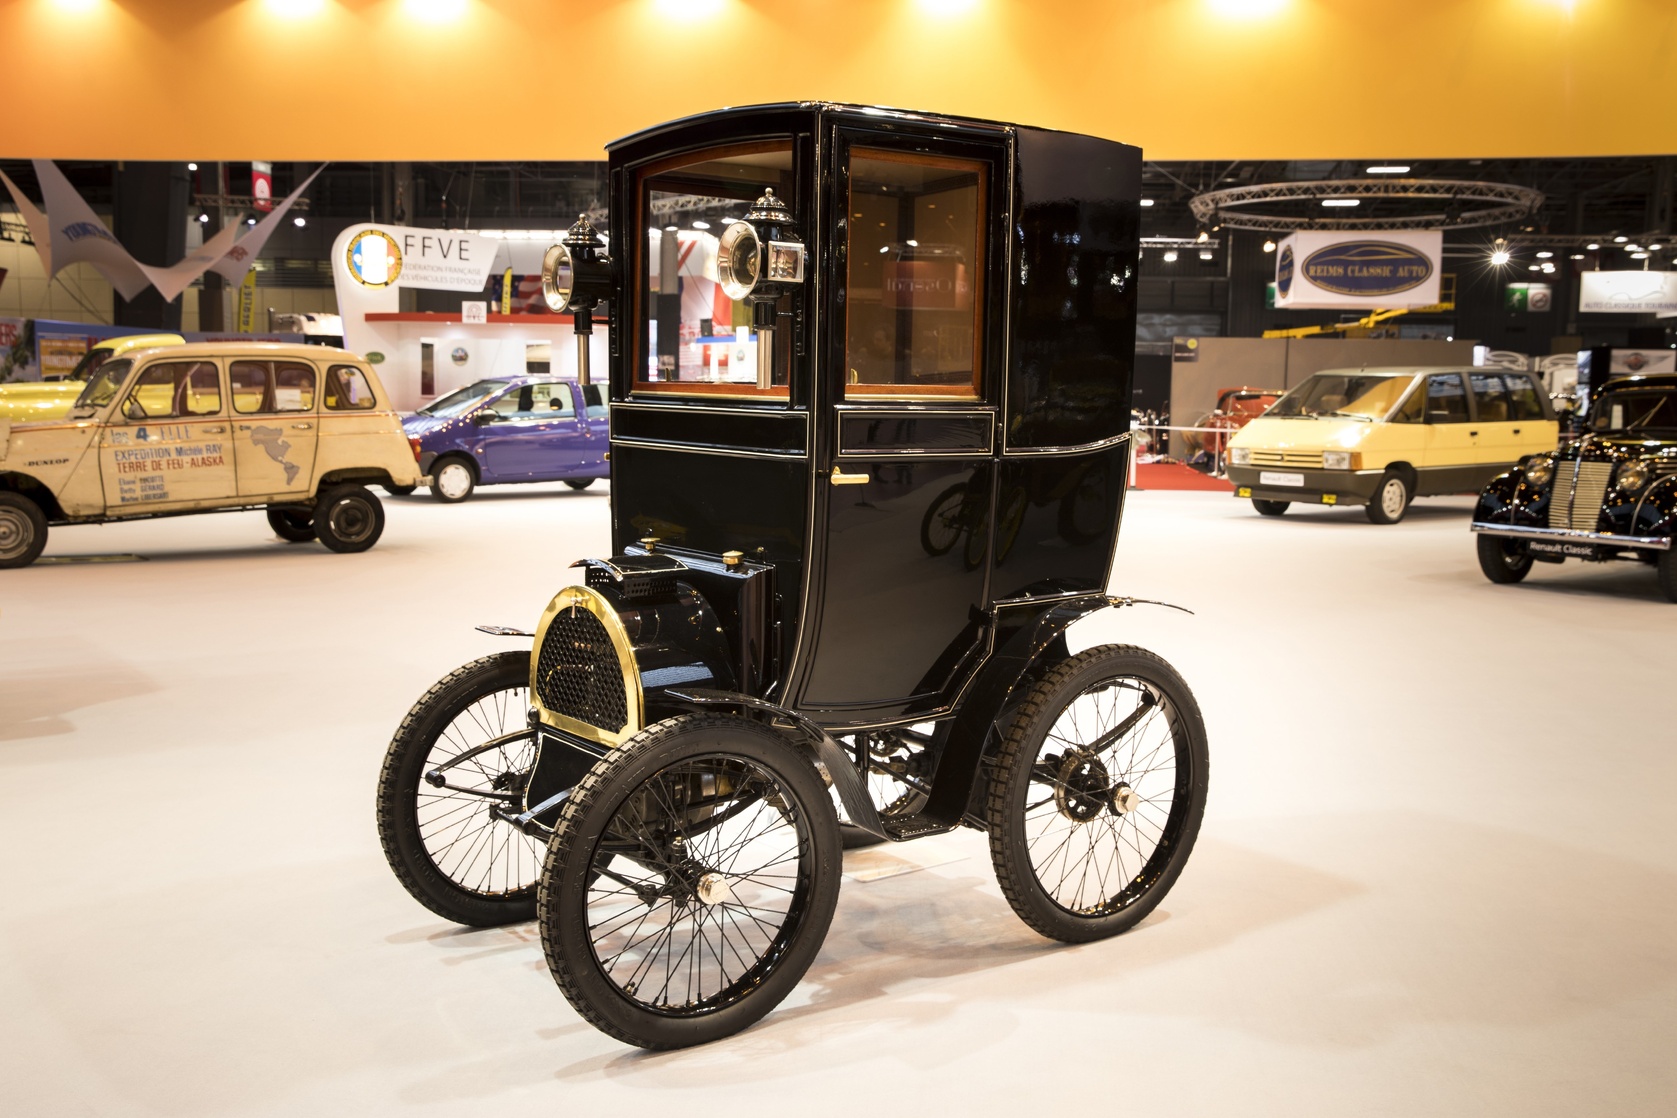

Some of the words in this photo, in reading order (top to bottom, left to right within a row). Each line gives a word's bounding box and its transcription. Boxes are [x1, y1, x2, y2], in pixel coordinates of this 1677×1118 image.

[404, 234, 470, 261] FFVE
[1308, 265, 1344, 277] REIMS
[1348, 265, 1393, 277] CLASSIC
[1396, 265, 1426, 277] AUTO
[136, 427, 148, 442] 4
[205, 444, 222, 455] RAY
[28, 459, 69, 467] DUNLOP
[117, 460, 148, 474] TERRE
[151, 459, 163, 471] DE
[1529, 541, 1562, 553] Renault
[1563, 544, 1593, 556] Classic
